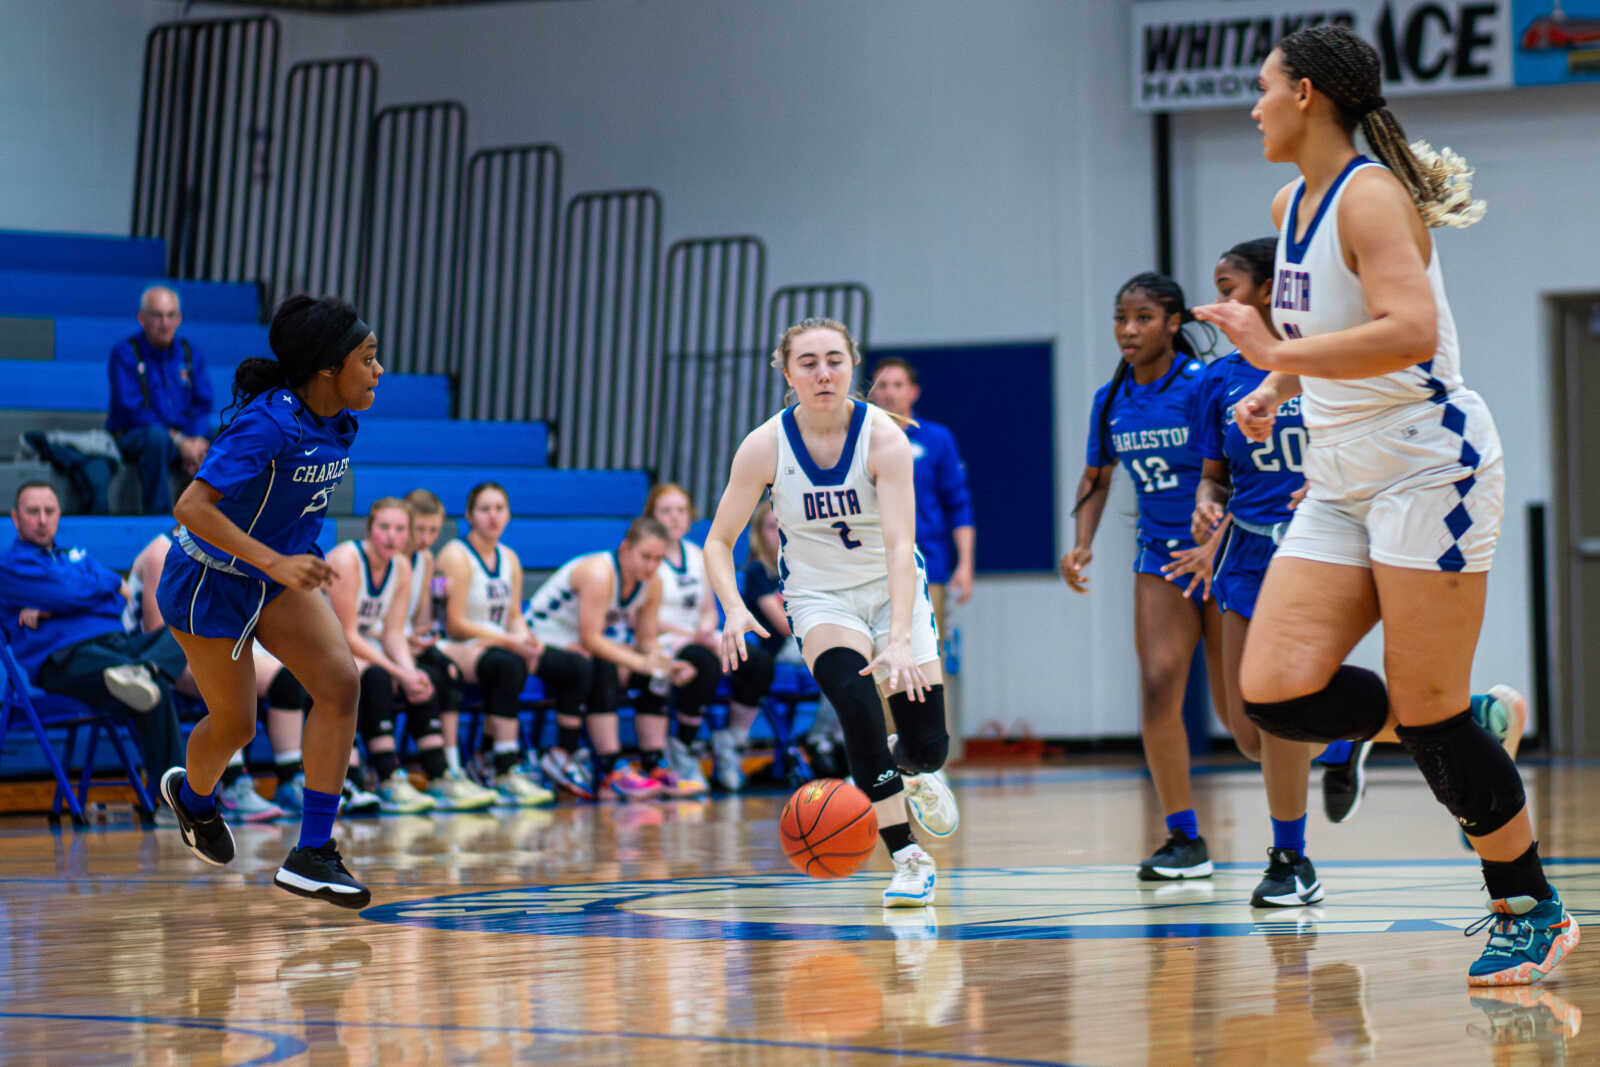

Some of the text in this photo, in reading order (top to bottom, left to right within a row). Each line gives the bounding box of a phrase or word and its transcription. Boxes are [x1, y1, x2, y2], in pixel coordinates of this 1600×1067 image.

[1245, 426, 1308, 474] 20
[1131, 455, 1180, 493] 12
[803, 488, 862, 521] DELTA
[831, 521, 862, 550] 2
